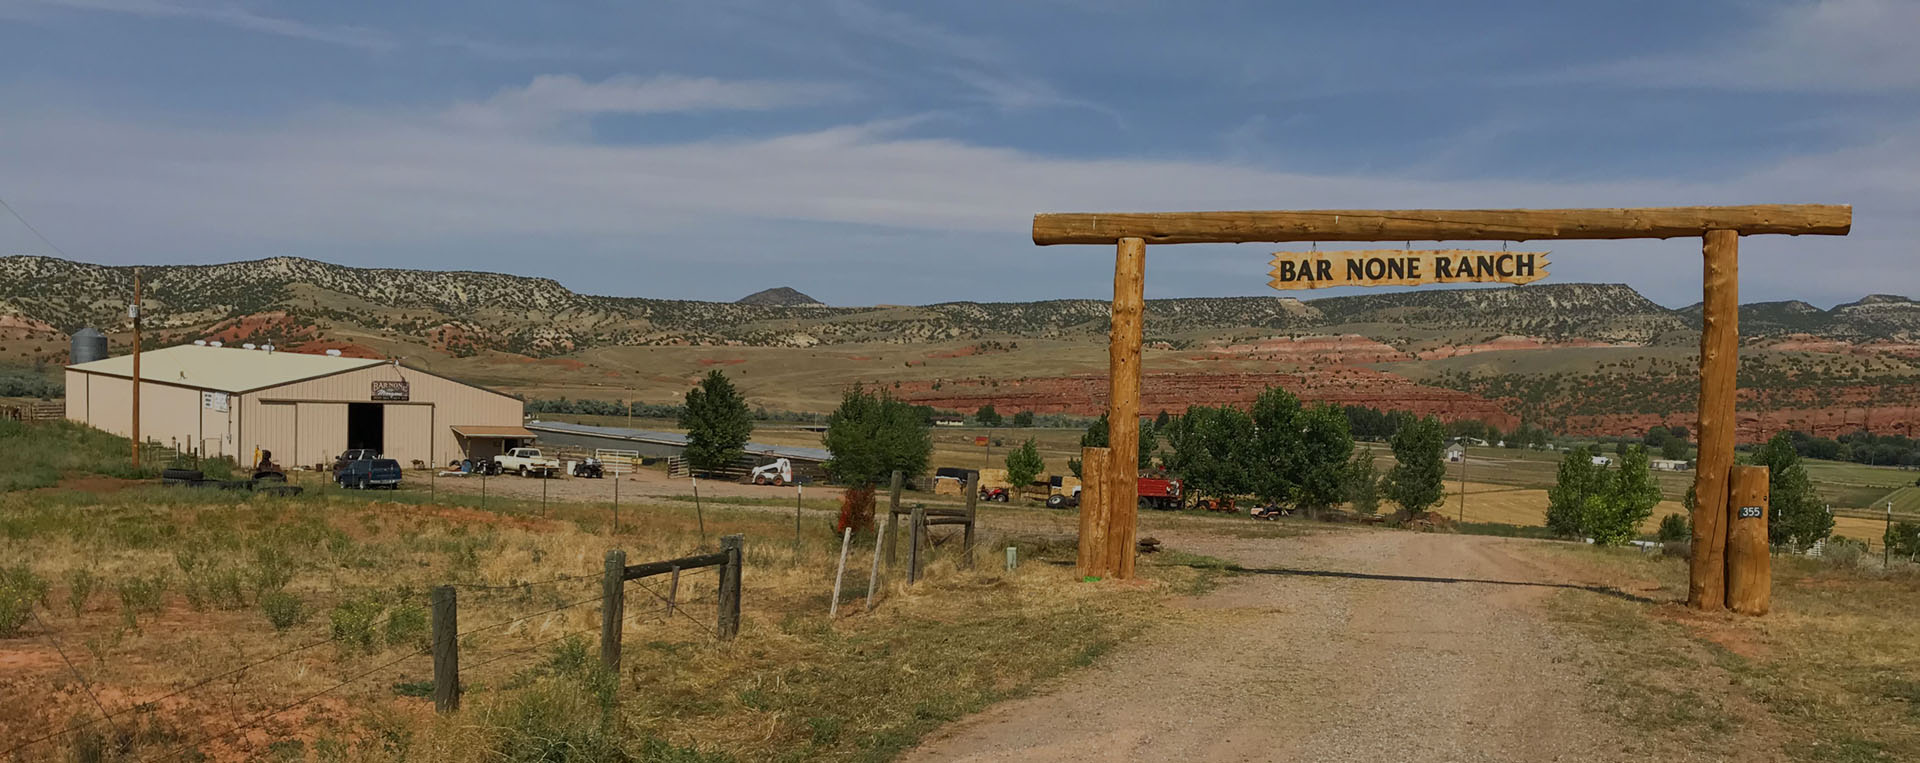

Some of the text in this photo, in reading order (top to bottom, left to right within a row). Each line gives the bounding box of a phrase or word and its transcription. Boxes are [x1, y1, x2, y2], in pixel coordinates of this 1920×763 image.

[1280, 254, 1535, 281] BAR NONE RANCH
[373, 382, 388, 391] BAR
[1743, 507, 1760, 516] 355
